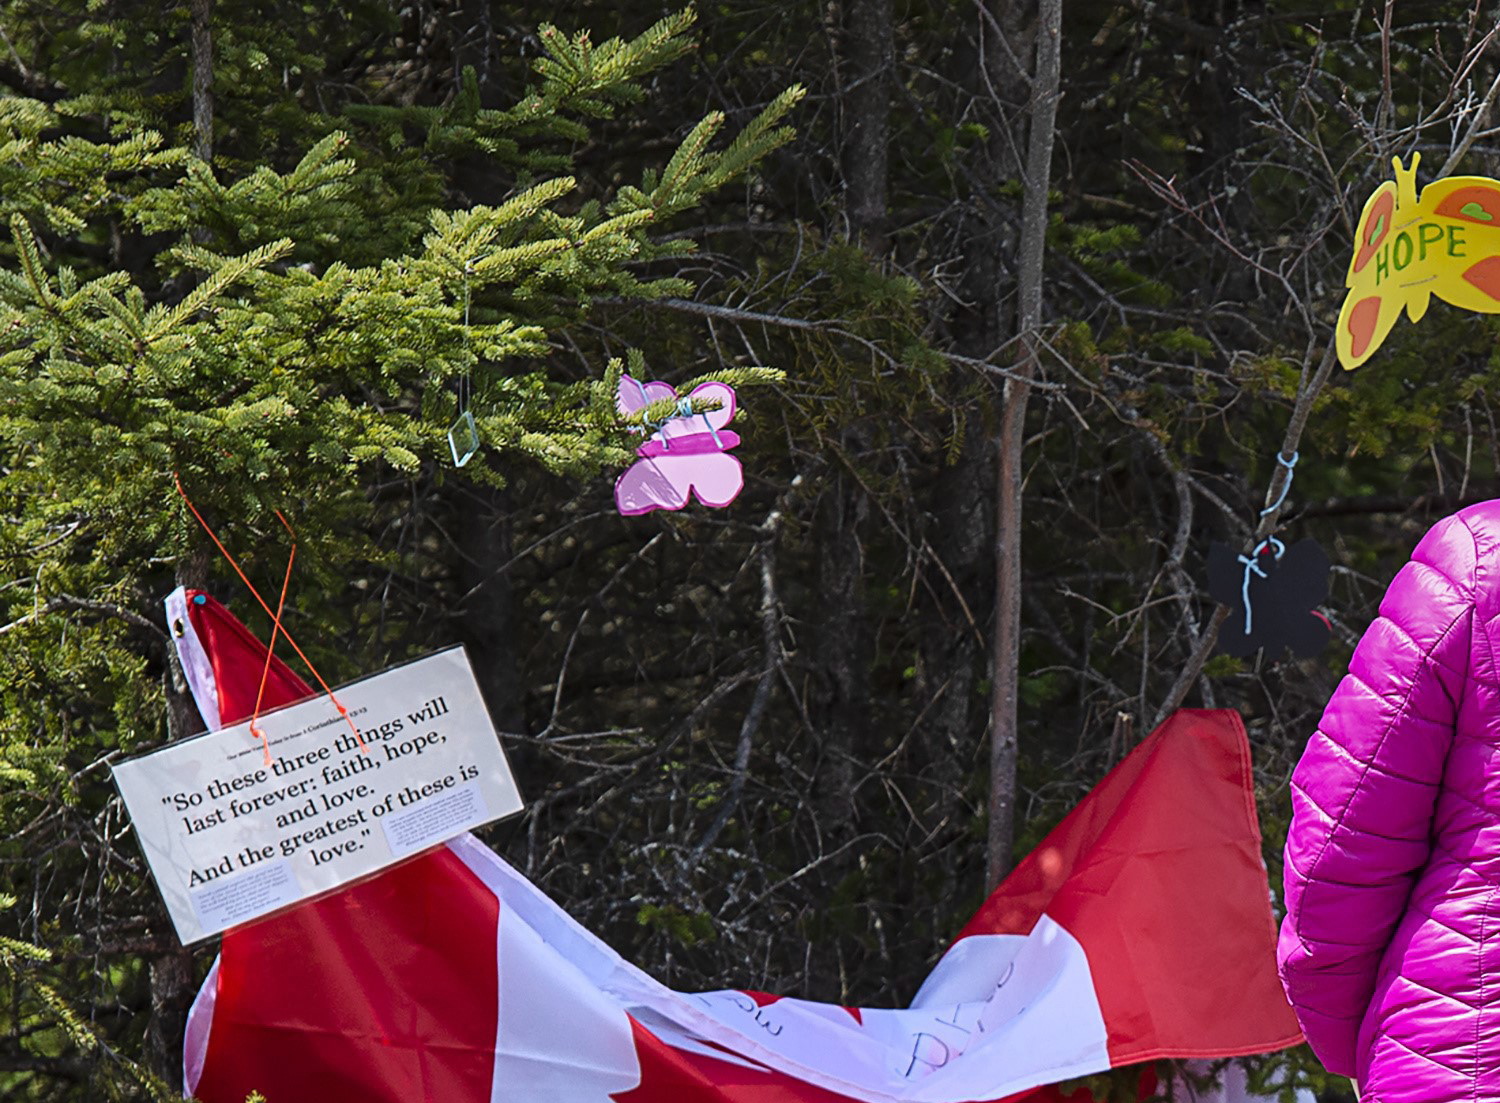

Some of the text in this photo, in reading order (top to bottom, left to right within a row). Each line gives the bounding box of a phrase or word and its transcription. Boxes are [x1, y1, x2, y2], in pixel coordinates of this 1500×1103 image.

[1376, 223, 1466, 286] HOPE
[162, 792, 203, 812] "So
[207, 770, 268, 799] these
[272, 746, 331, 777] three
[334, 718, 404, 754] things
[407, 696, 450, 725] will
[183, 731, 447, 835] last forever: faith, hope,
[189, 856, 235, 887] And
[238, 845, 275, 866] the
[279, 809, 368, 857] greatest
[372, 794, 395, 817] of
[398, 775, 456, 807] these
[459, 764, 479, 782] is
[276, 784, 375, 828] and love.
[310, 828, 371, 866] love."
